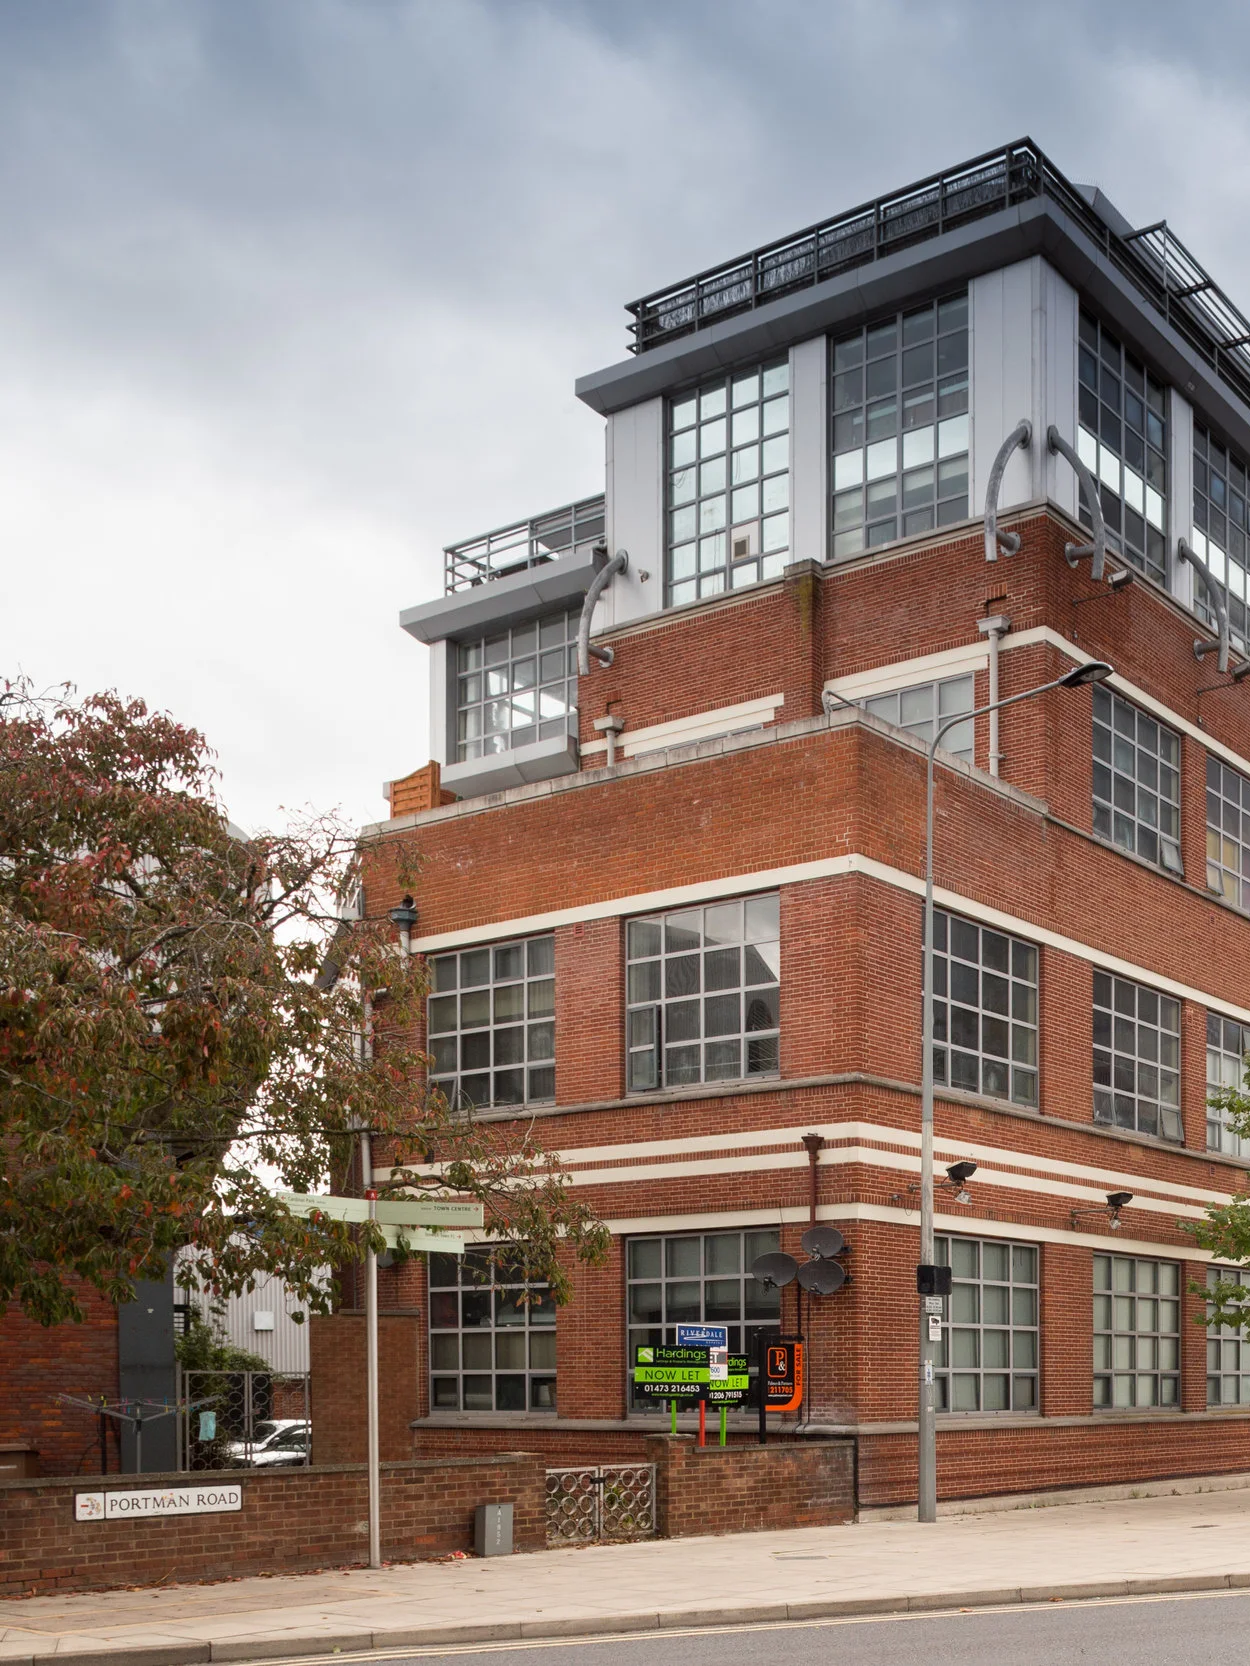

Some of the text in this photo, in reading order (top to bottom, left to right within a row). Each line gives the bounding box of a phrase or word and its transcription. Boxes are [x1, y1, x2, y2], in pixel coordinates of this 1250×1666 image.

[680, 1329, 723, 1339] RIVERDALE
[656, 1347, 707, 1361] Hardings
[710, 1352, 719, 1364] ET
[728, 1356, 747, 1368] dings
[645, 1370, 700, 1380] NOW LET
[644, 1384, 700, 1393] 01473 216453
[732, 1378, 743, 1388] LET
[110, 1492, 239, 1512] PORTMAN ROAD
